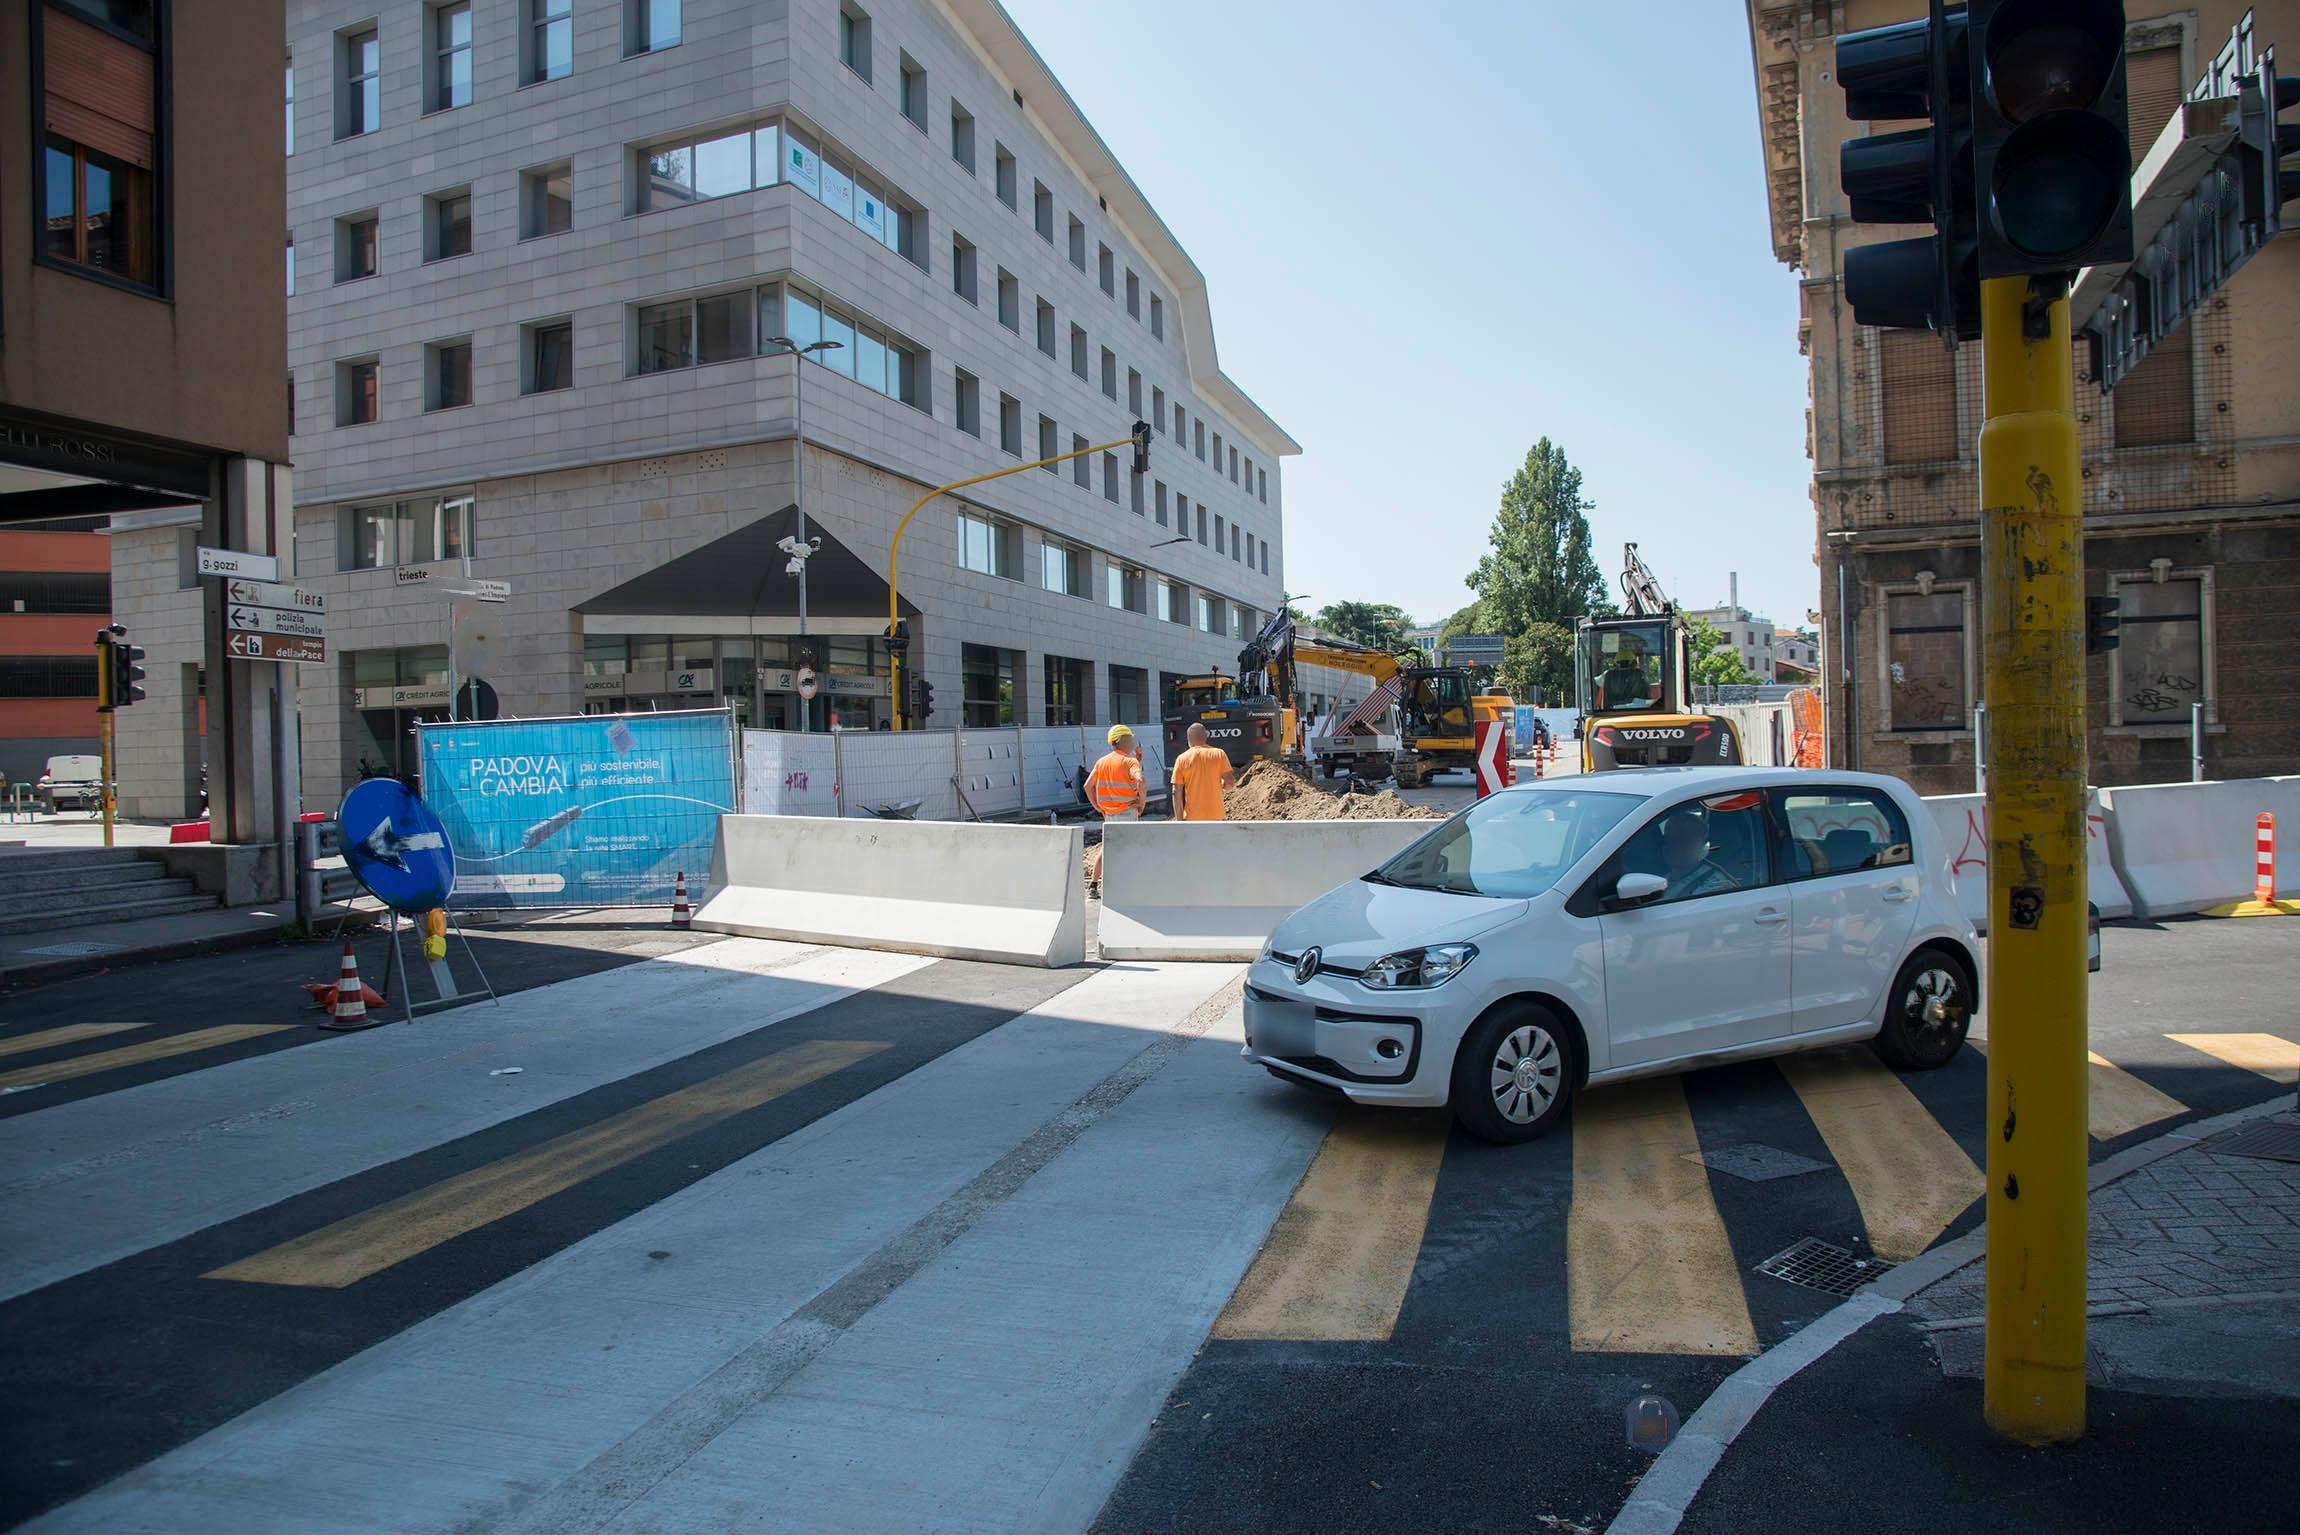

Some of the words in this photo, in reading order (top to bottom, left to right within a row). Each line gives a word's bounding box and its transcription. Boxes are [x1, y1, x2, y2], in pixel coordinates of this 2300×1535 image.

[398, 569, 429, 581] trieste
[294, 589, 323, 607] fiera
[276, 613, 305, 624] polizia
[276, 622, 323, 636] municipale
[301, 649, 322, 660] Pace
[584, 681, 622, 690] AGRICOLE
[430, 690, 451, 699] AGRIC
[1621, 728, 1685, 740] VOLVO
[471, 755, 562, 777] PADOVA
[479, 775, 564, 798] CAMBIA
